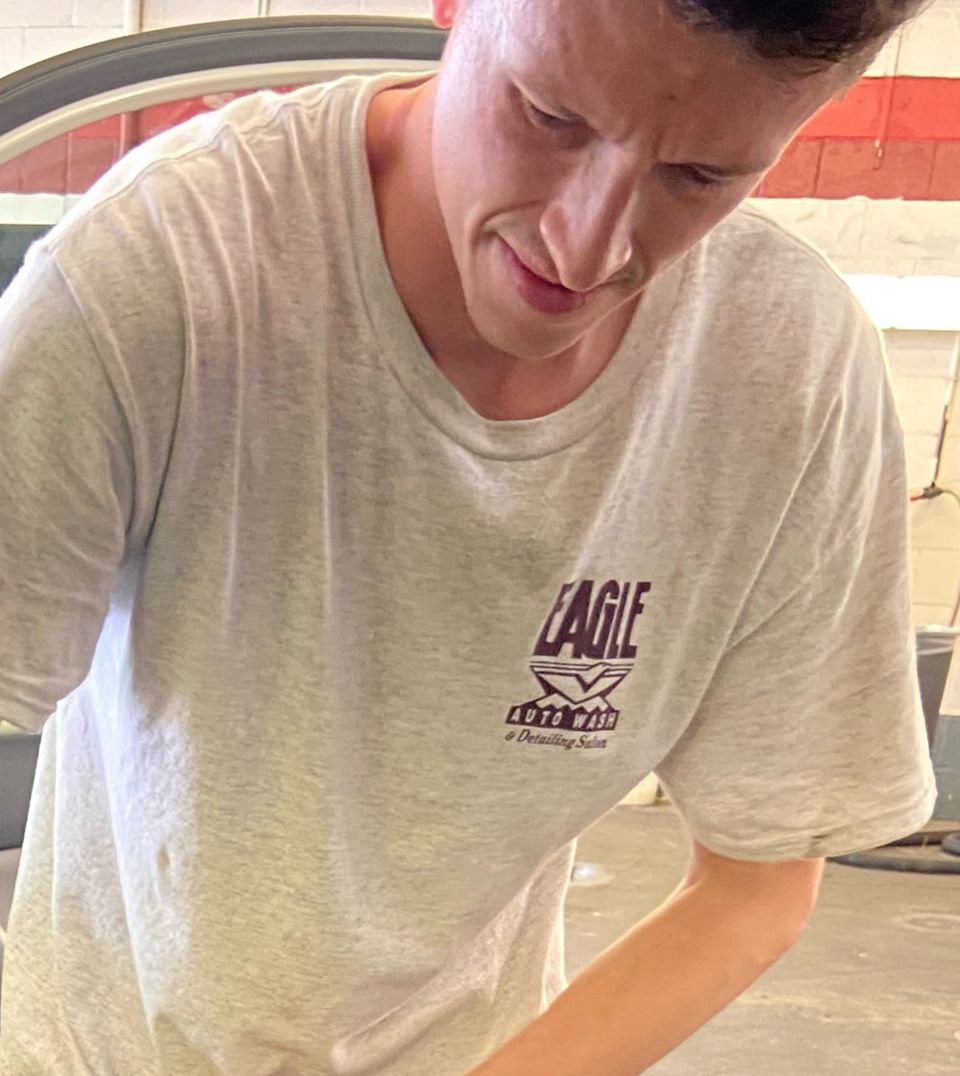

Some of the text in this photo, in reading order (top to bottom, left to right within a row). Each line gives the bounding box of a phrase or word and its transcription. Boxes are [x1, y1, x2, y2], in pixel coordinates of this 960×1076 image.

[533, 579, 652, 660] EAGLE
[510, 707, 617, 730] AUTO WASH
[517, 729, 576, 751] Detailing
